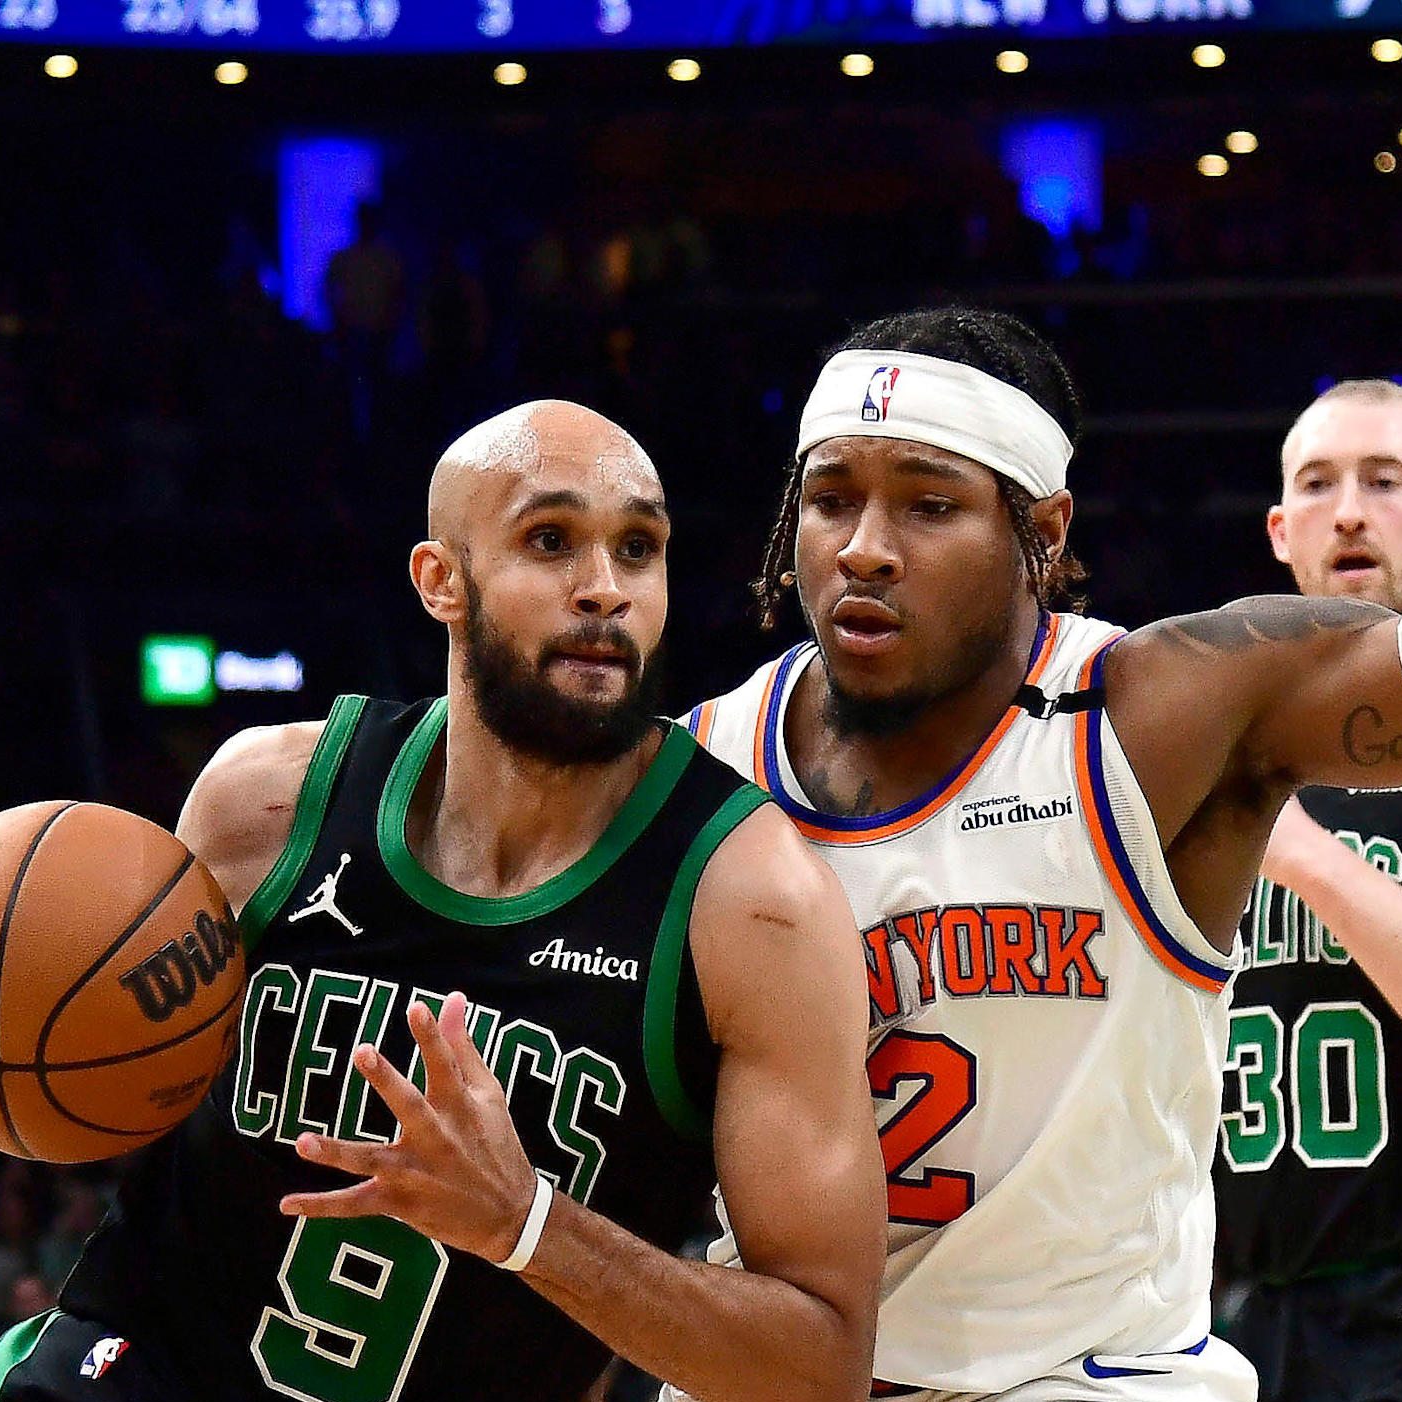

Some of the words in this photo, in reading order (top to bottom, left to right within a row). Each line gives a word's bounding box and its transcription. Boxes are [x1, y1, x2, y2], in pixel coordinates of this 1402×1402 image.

[960, 811, 1004, 832] abu
[961, 794, 1021, 812] experience
[528, 938, 639, 981] Amica
[889, 903, 1110, 1007] YORK
[1221, 1001, 1390, 1173] 30
[865, 1027, 978, 1229] 2
